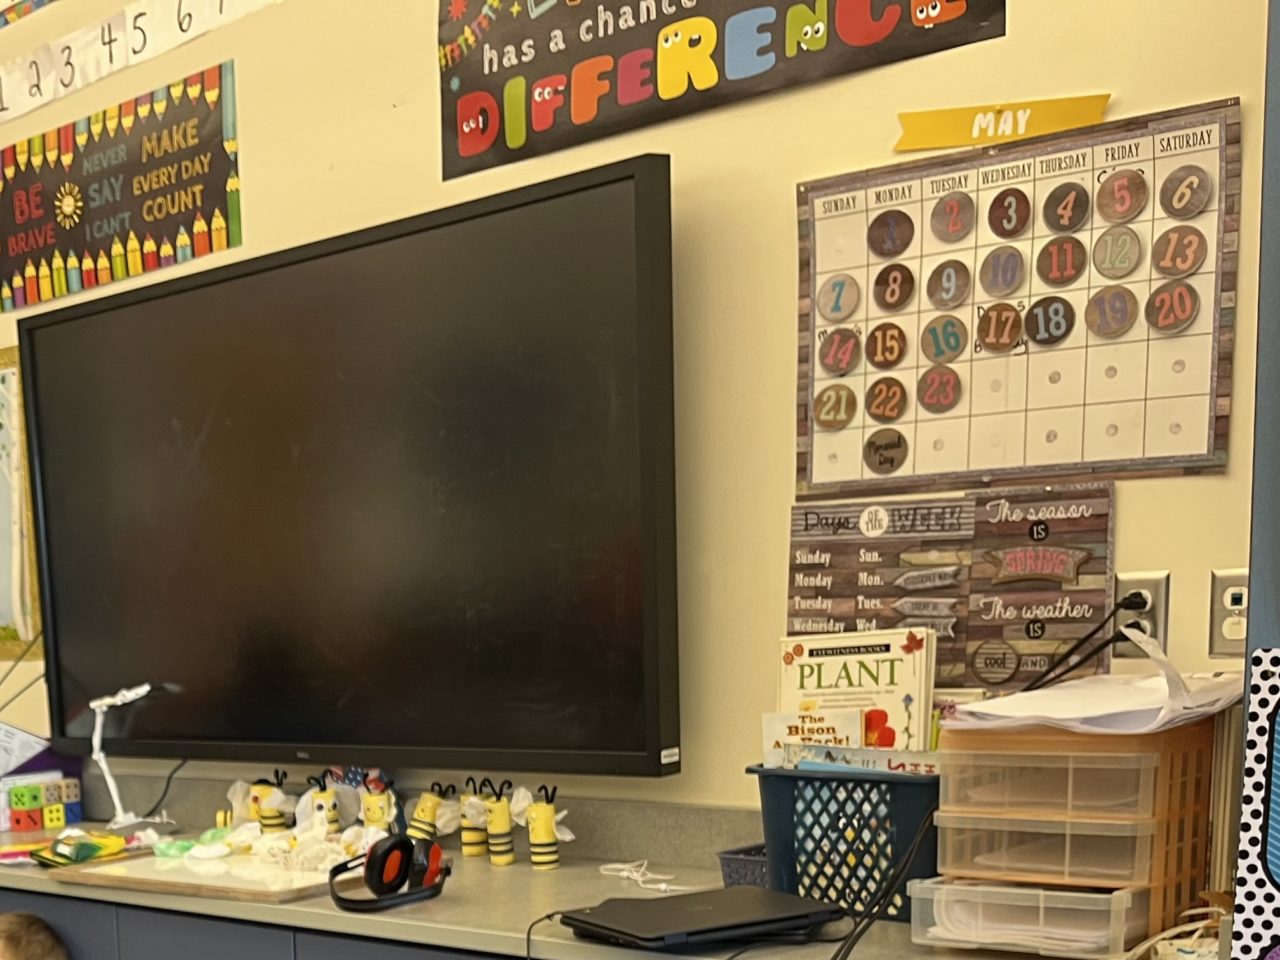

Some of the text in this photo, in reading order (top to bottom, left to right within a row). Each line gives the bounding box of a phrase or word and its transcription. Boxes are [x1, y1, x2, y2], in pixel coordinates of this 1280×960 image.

[29, 61, 44, 97] 2
[59, 46, 75, 88] 3
[100, 22, 118, 64] 4
[131, 12, 147, 55] 5
[483, 38, 535, 75] has
[549, 28, 566, 53] a
[972, 108, 1031, 138] MAY
[141, 117, 199, 163] MAKE
[83, 145, 127, 176] NEVER
[132, 152, 212, 196] EVERY DAY
[822, 129, 1213, 215] SUNDAY MONDAY TUESDAY WEDNESDAY THURSDAY FRIDAY SATURDAY
[13, 183, 45, 225] BE
[87, 175, 124, 209] SAY
[142, 185, 204, 222] COUNT
[946, 200, 963, 234] 2
[1002, 196, 1017, 230] 3
[1056, 191, 1077, 225] 4
[1114, 177, 1132, 213] 5
[1172, 175, 1199, 210] 6
[7, 222, 56, 257] BRAVE
[93, 212, 132, 239] CAN'T
[831, 232, 1199, 313] 7 8 9 10 11 12 13
[824, 334, 855, 368] 14
[874, 329, 899, 363] 15
[928, 320, 961, 358] 16
[985, 310, 1016, 344] 17
[1033, 302, 1067, 340] 18
[1095, 291, 1129, 331] 19
[1155, 285, 1192, 328] 20
[820, 373, 955, 421] 21 22 23
[803, 511, 857, 536] Days
[893, 505, 962, 533] WEEK
[986, 499, 1092, 523] The season
[1033, 525, 1046, 540] IS
[795, 548, 882, 567] Sunday Sun.
[1006, 546, 1068, 574] SPRING
[794, 572, 884, 590] Monday Mon.
[793, 595, 884, 613] Tuesday Tues.
[979, 597, 1093, 620] The weather
[793, 618, 845, 632] Wednesday
[1030, 623, 1042, 637] IS
[797, 658, 904, 690] PLANT
[1021, 656, 1048, 671] AND
[787, 725, 836, 736] Bison
[799, 715, 825, 724] The
